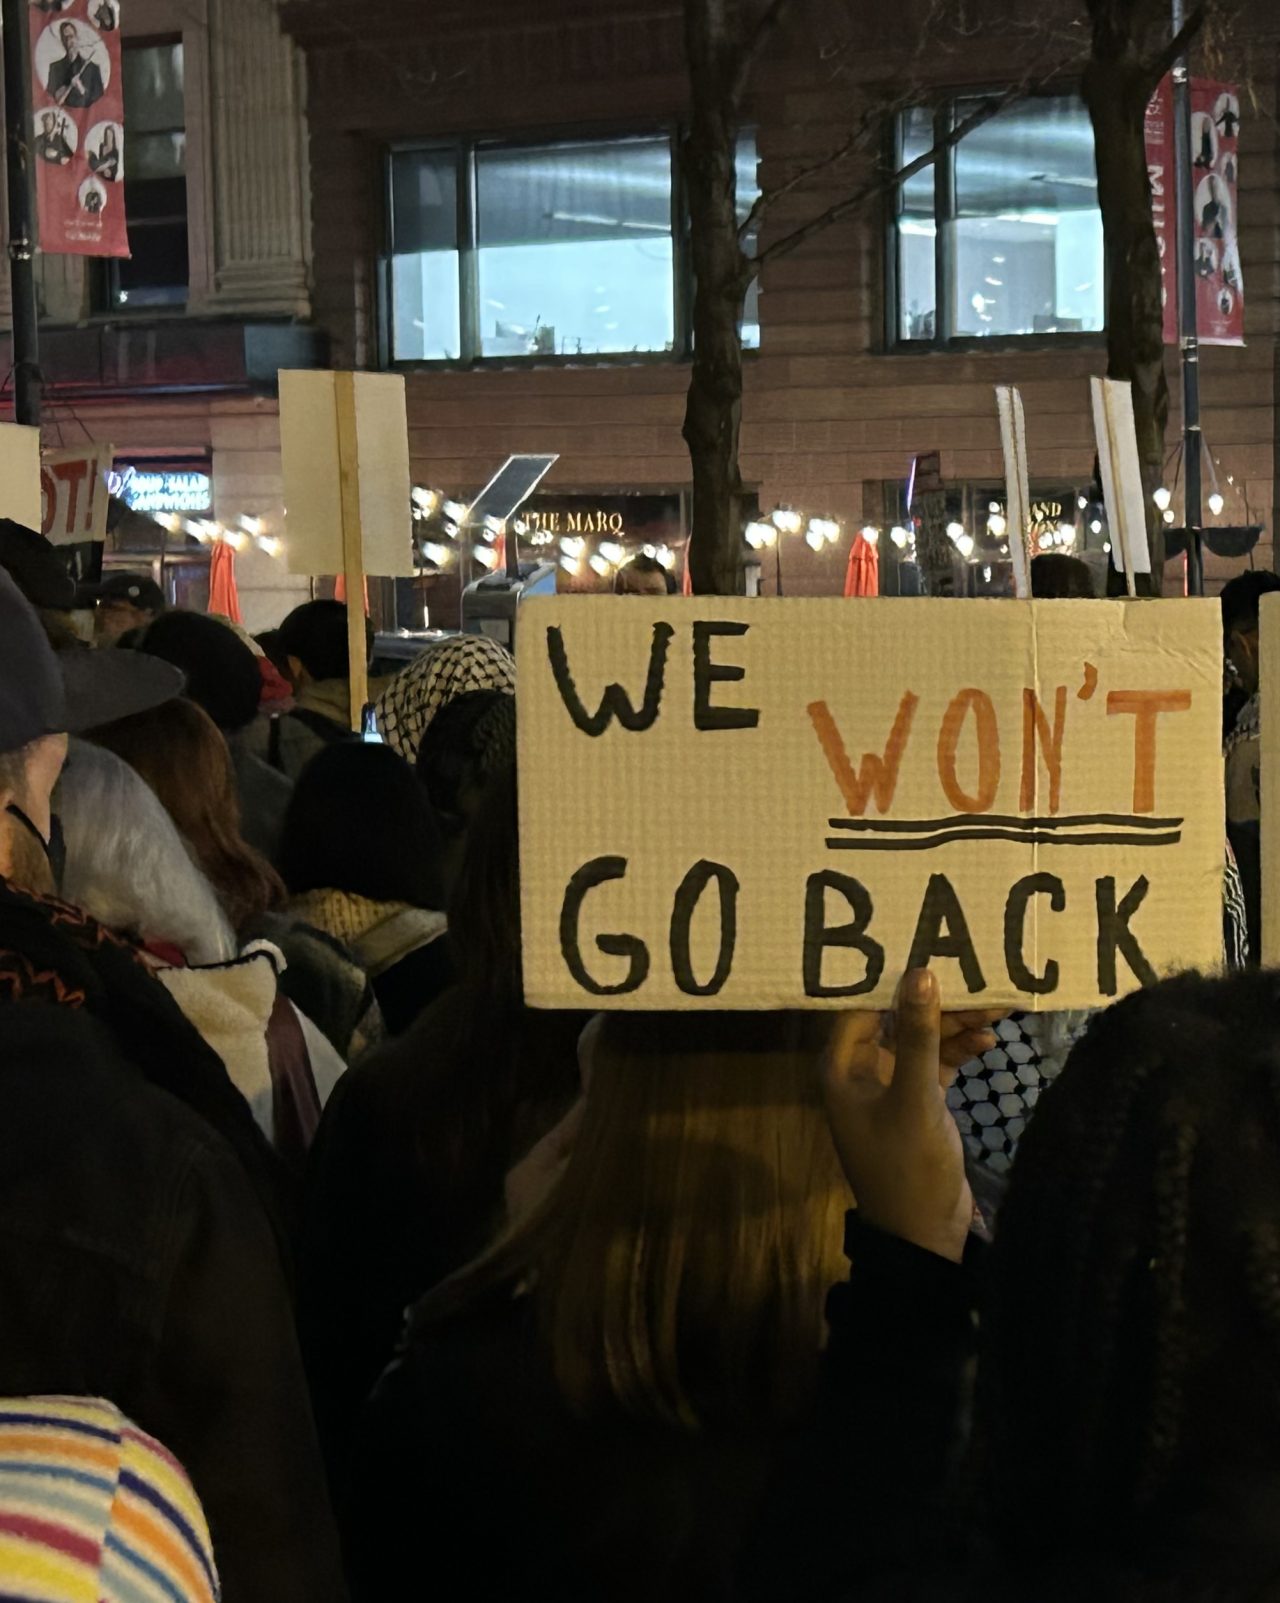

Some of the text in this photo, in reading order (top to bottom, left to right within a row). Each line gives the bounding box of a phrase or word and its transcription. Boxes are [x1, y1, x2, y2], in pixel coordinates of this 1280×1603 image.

[521, 510, 625, 536] THE MARQ
[546, 620, 760, 737] WE
[806, 661, 1192, 816] WON'T
[559, 856, 1159, 998] GO BACK
